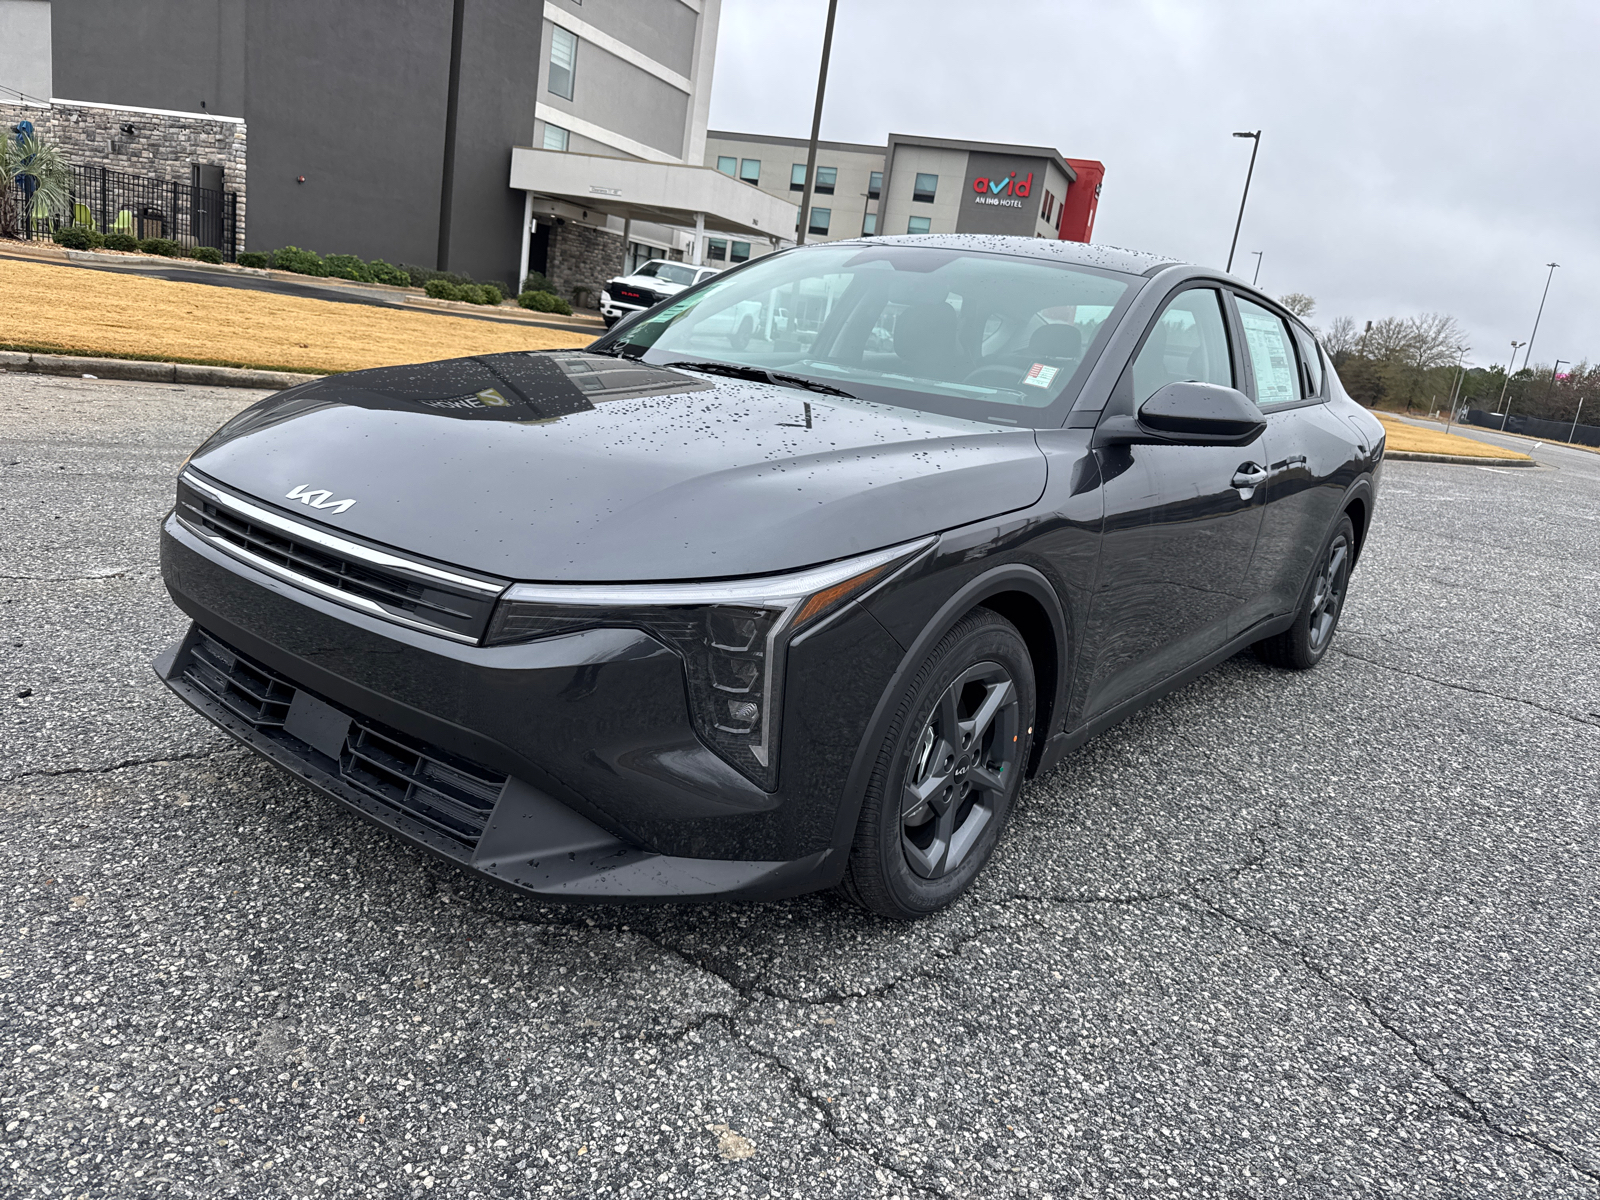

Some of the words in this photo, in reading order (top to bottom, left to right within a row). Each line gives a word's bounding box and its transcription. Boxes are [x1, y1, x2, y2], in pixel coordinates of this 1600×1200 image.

[973, 171, 1033, 197] avid
[975, 196, 986, 205] AN
[986, 197, 999, 206] IHG
[1000, 199, 1022, 208] HOTEL
[621, 290, 640, 298] RAM
[285, 483, 357, 515] KIA
[903, 670, 949, 757] KUMHO
